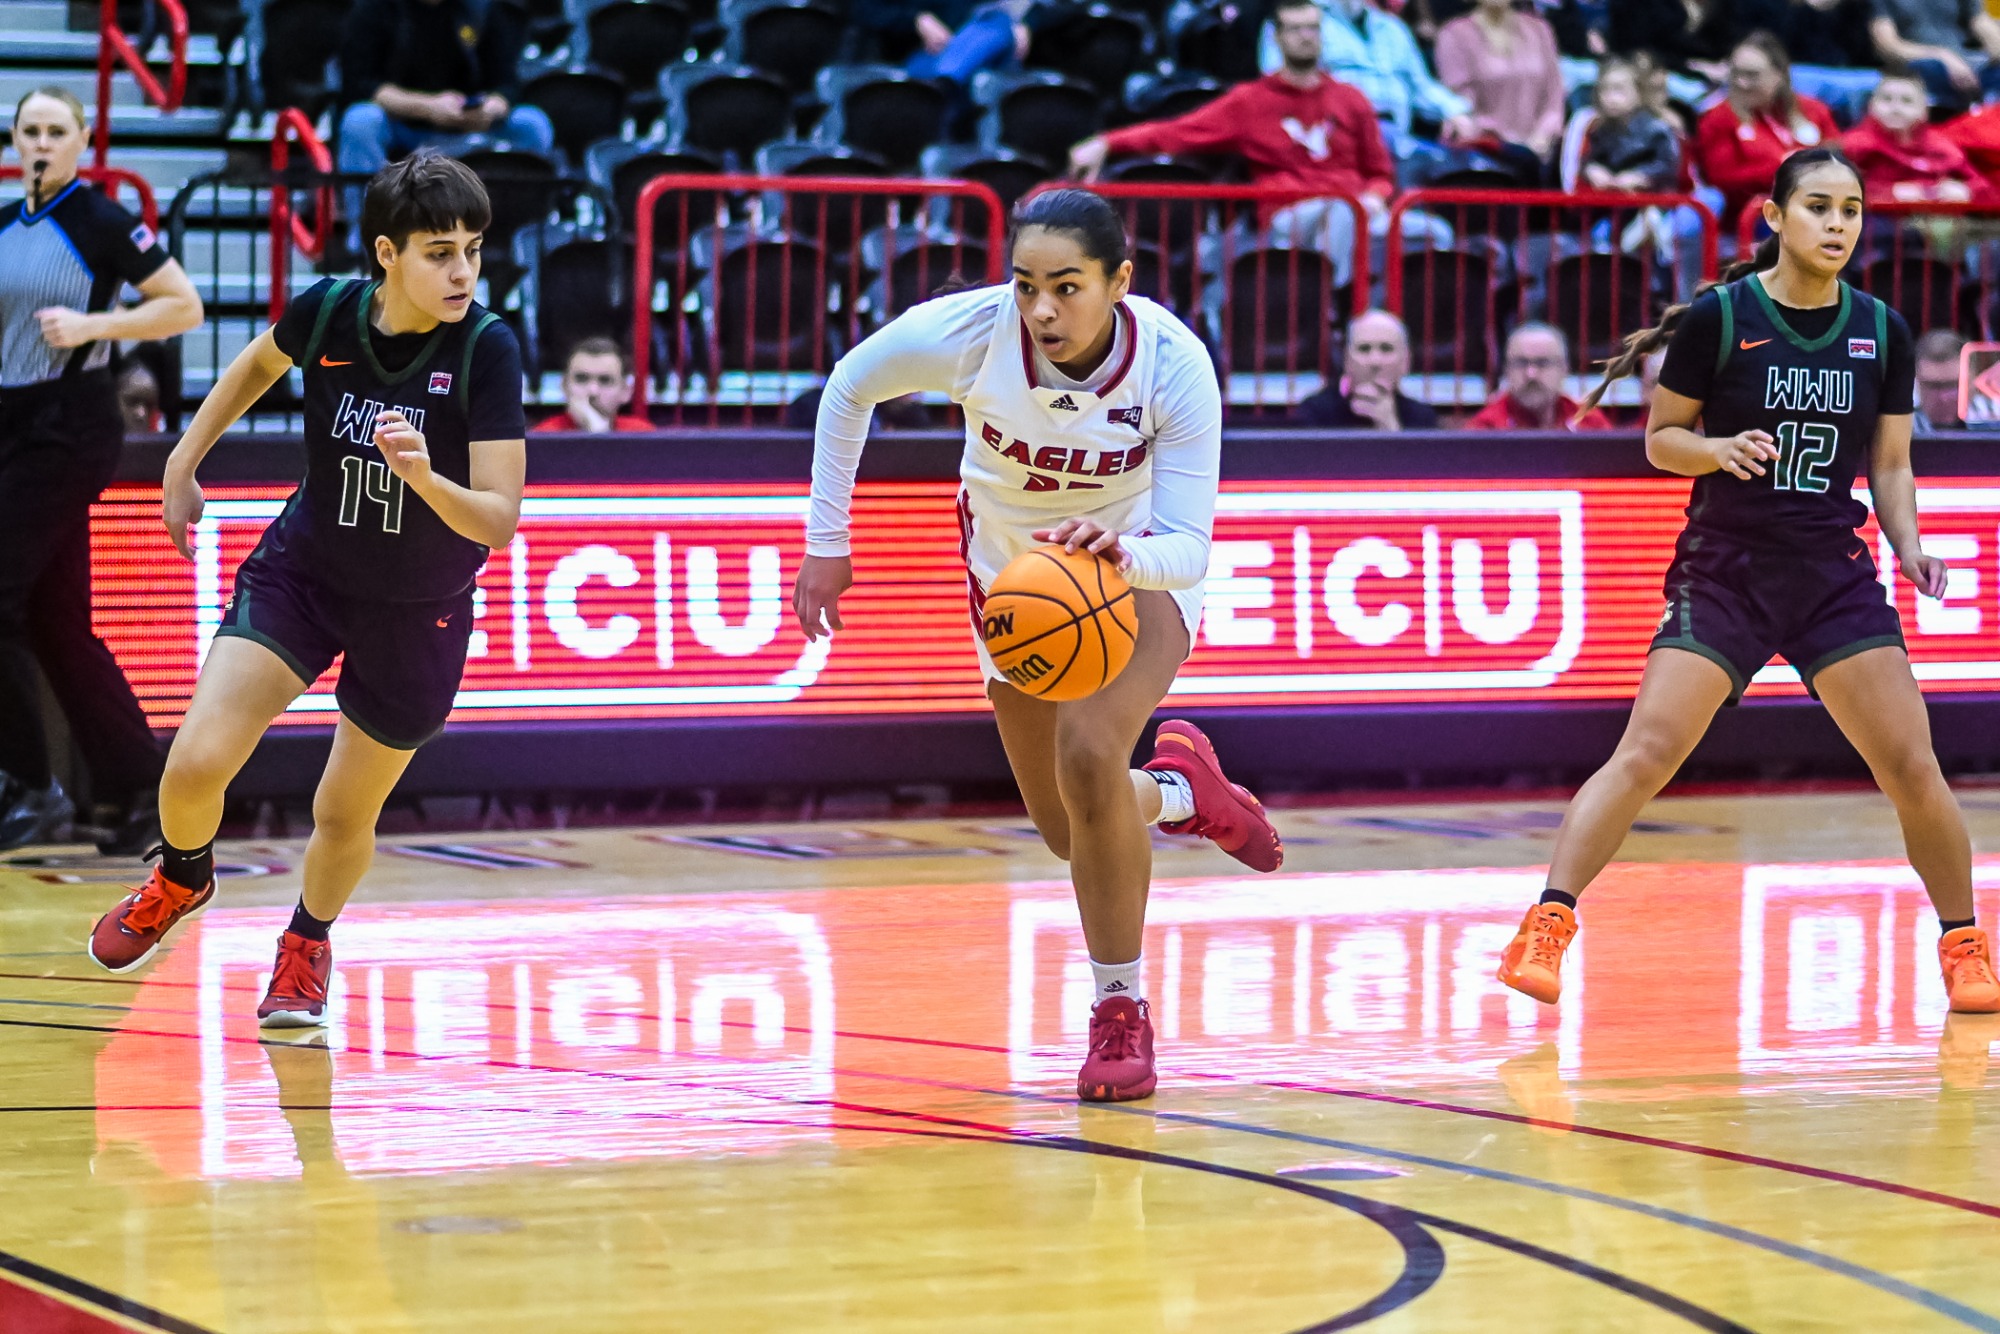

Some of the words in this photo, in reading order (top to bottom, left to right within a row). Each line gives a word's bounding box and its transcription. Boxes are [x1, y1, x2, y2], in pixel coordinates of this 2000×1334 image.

[1765, 366, 1852, 413] WWU
[982, 421, 1148, 476] EAGLES
[1774, 422, 1838, 493] 12
[338, 455, 404, 534] 14
